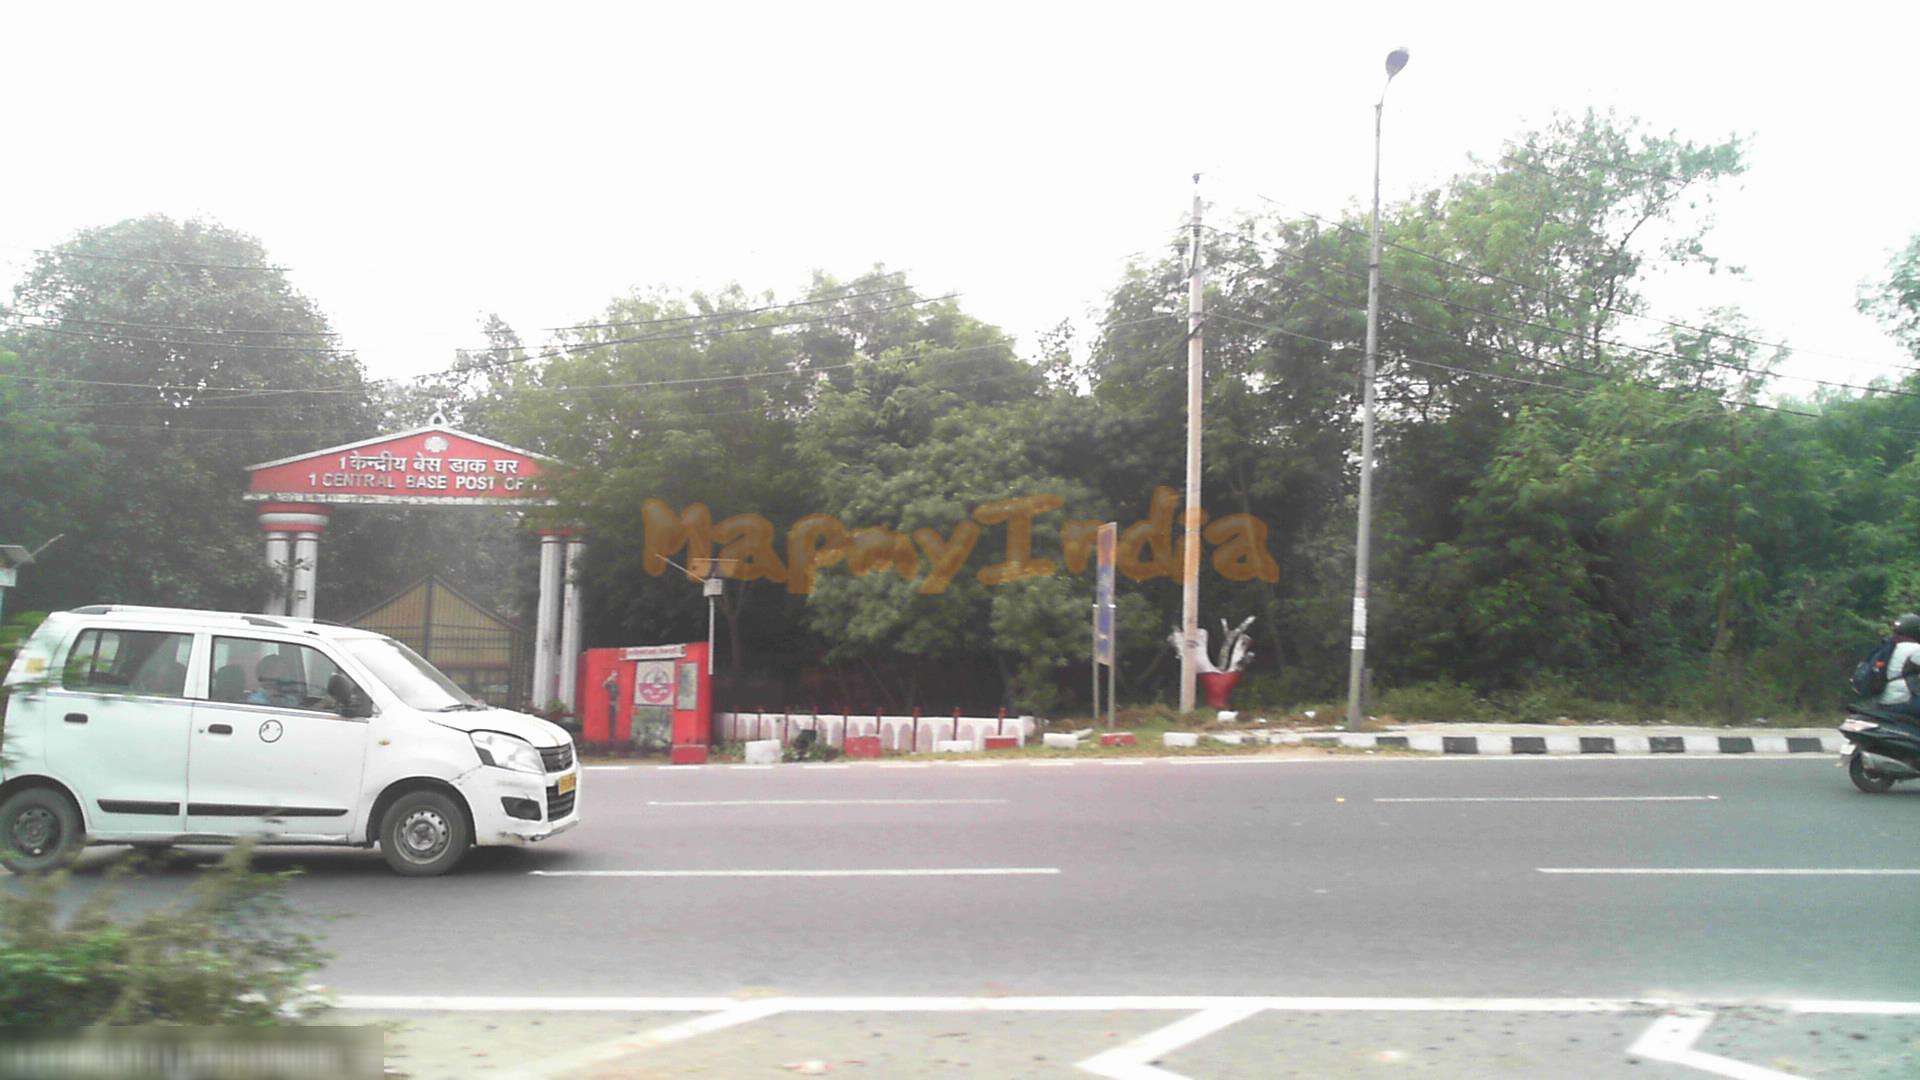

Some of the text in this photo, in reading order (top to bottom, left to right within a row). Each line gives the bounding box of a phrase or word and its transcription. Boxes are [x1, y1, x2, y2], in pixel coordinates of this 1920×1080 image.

[349, 450, 408, 472] केन्द्रीय
[412, 451, 442, 472] बेस
[448, 458, 487, 473] डाक
[493, 459, 520, 474] घर
[308, 473, 316, 486] 1
[322, 473, 396, 488] CENTRAL
[405, 475, 448, 489] BASE
[456, 476, 496, 490] POST
